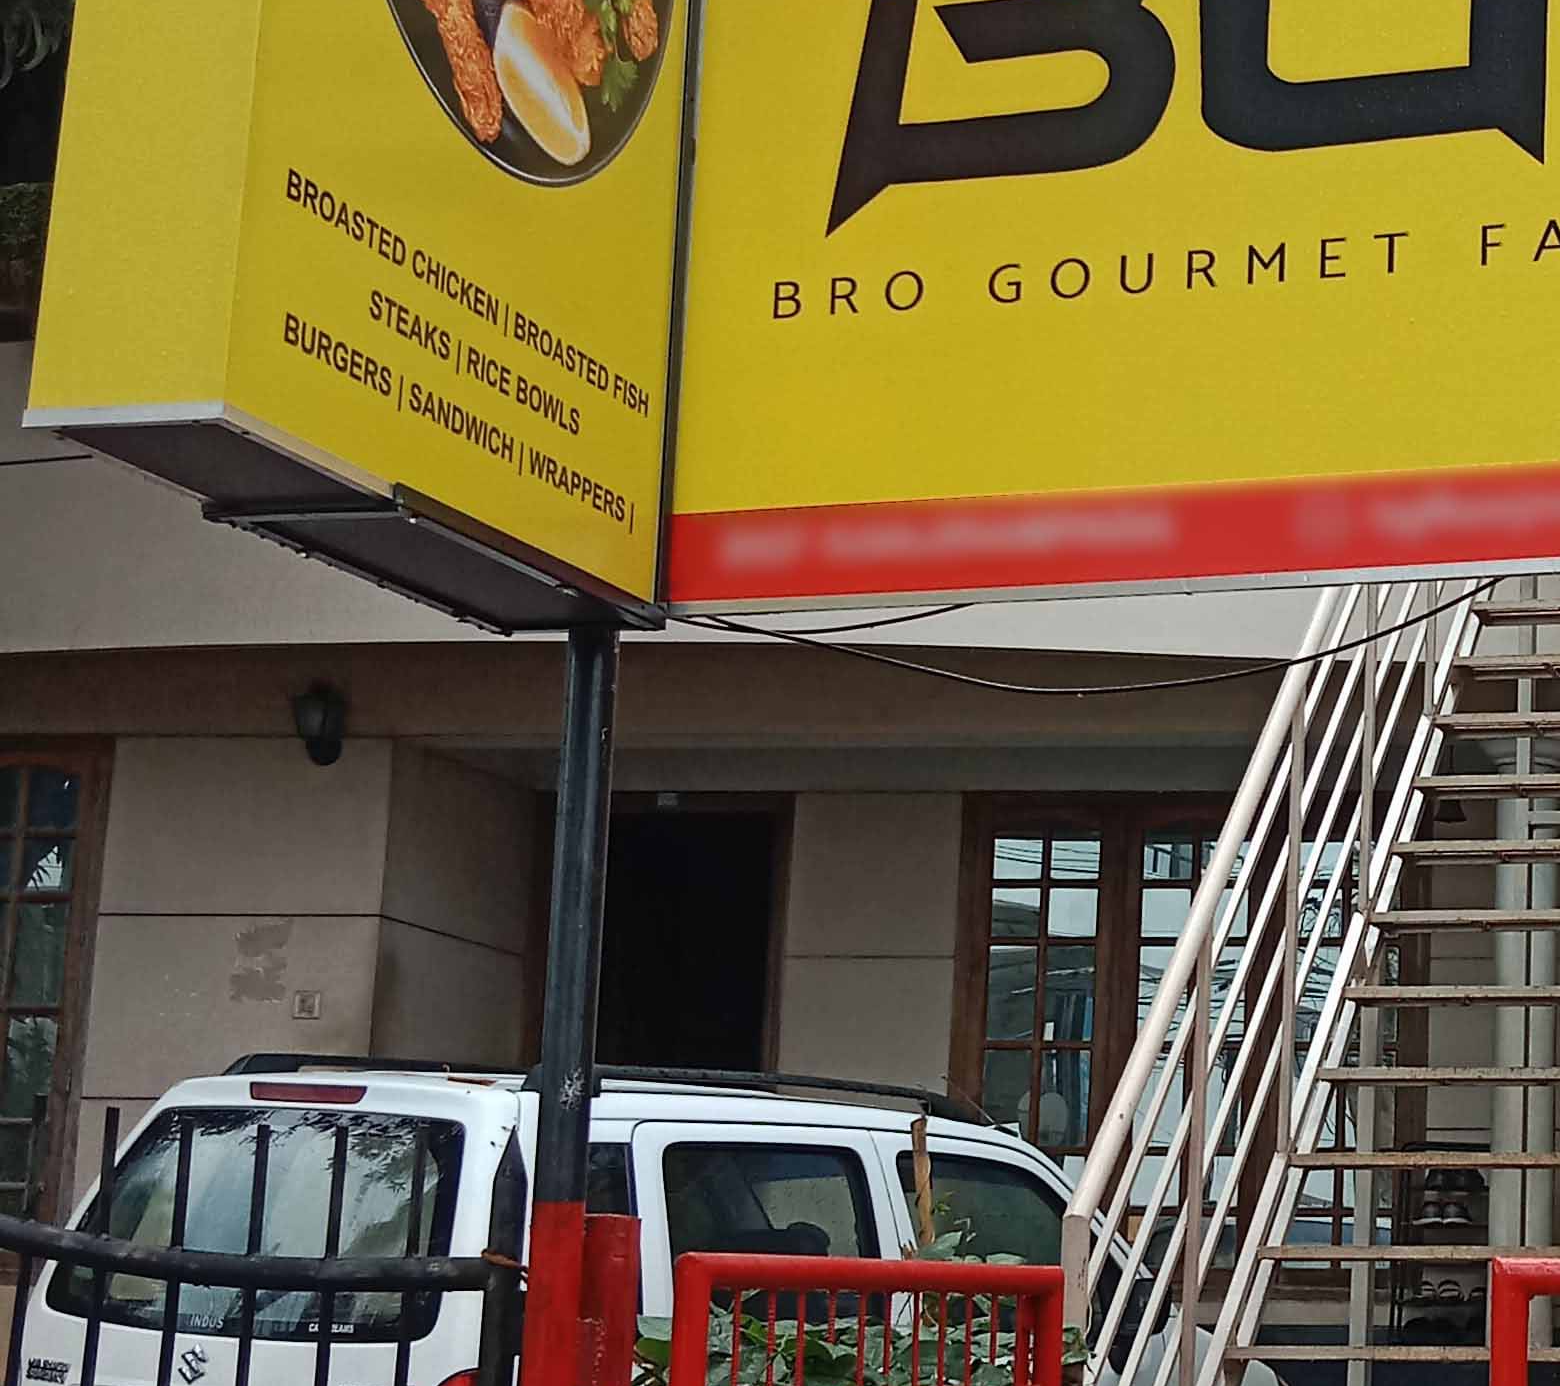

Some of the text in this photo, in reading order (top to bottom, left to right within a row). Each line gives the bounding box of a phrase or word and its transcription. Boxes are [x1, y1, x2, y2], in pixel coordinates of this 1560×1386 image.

[286, 167, 406, 267] BROASTED
[411, 249, 500, 326] CHICKEN
[513, 312, 608, 391] BROASTED
[612, 373, 650, 417] FISH
[771, 269, 925, 320] BRO
[987, 231, 1409, 305] GOURMET
[284, 312, 392, 396] BURGERS
[409, 383, 515, 464] SANDWICH
[529, 447, 626, 522] WRAPPERS
[368, 289, 451, 361] STEAKS
[466, 347, 510, 396] RICE
[515, 379, 580, 435] BOWLS
[189, 1313, 225, 1330] INDUS
